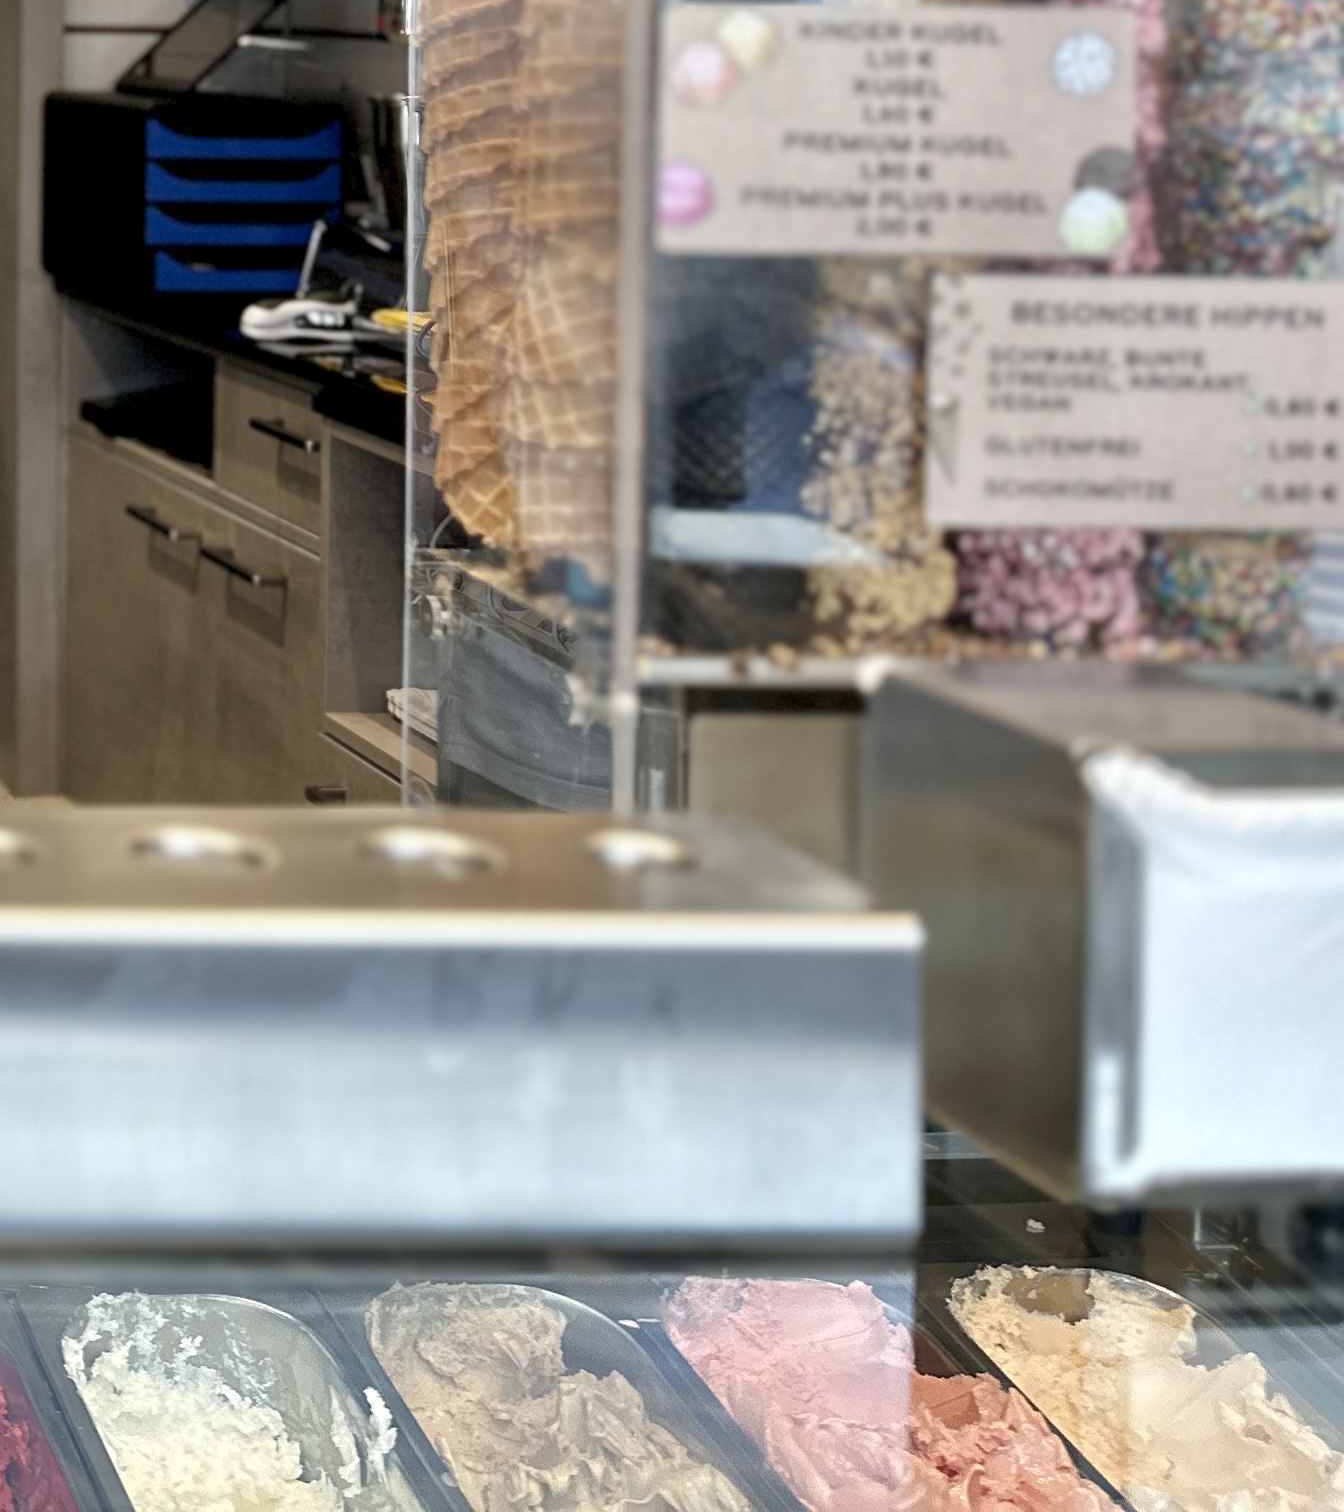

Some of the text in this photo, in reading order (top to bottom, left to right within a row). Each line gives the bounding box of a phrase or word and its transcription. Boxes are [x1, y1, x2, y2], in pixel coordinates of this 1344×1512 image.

[912, 22, 1002, 45] KUGEL
[852, 78, 945, 97] KUGEL
[782, 132, 1011, 157] PREMIUM KUGEL
[740, 189, 1051, 215] PREMIUM PLUS KUGEL
[1011, 300, 1326, 330] BESONDERE HIPPEN
